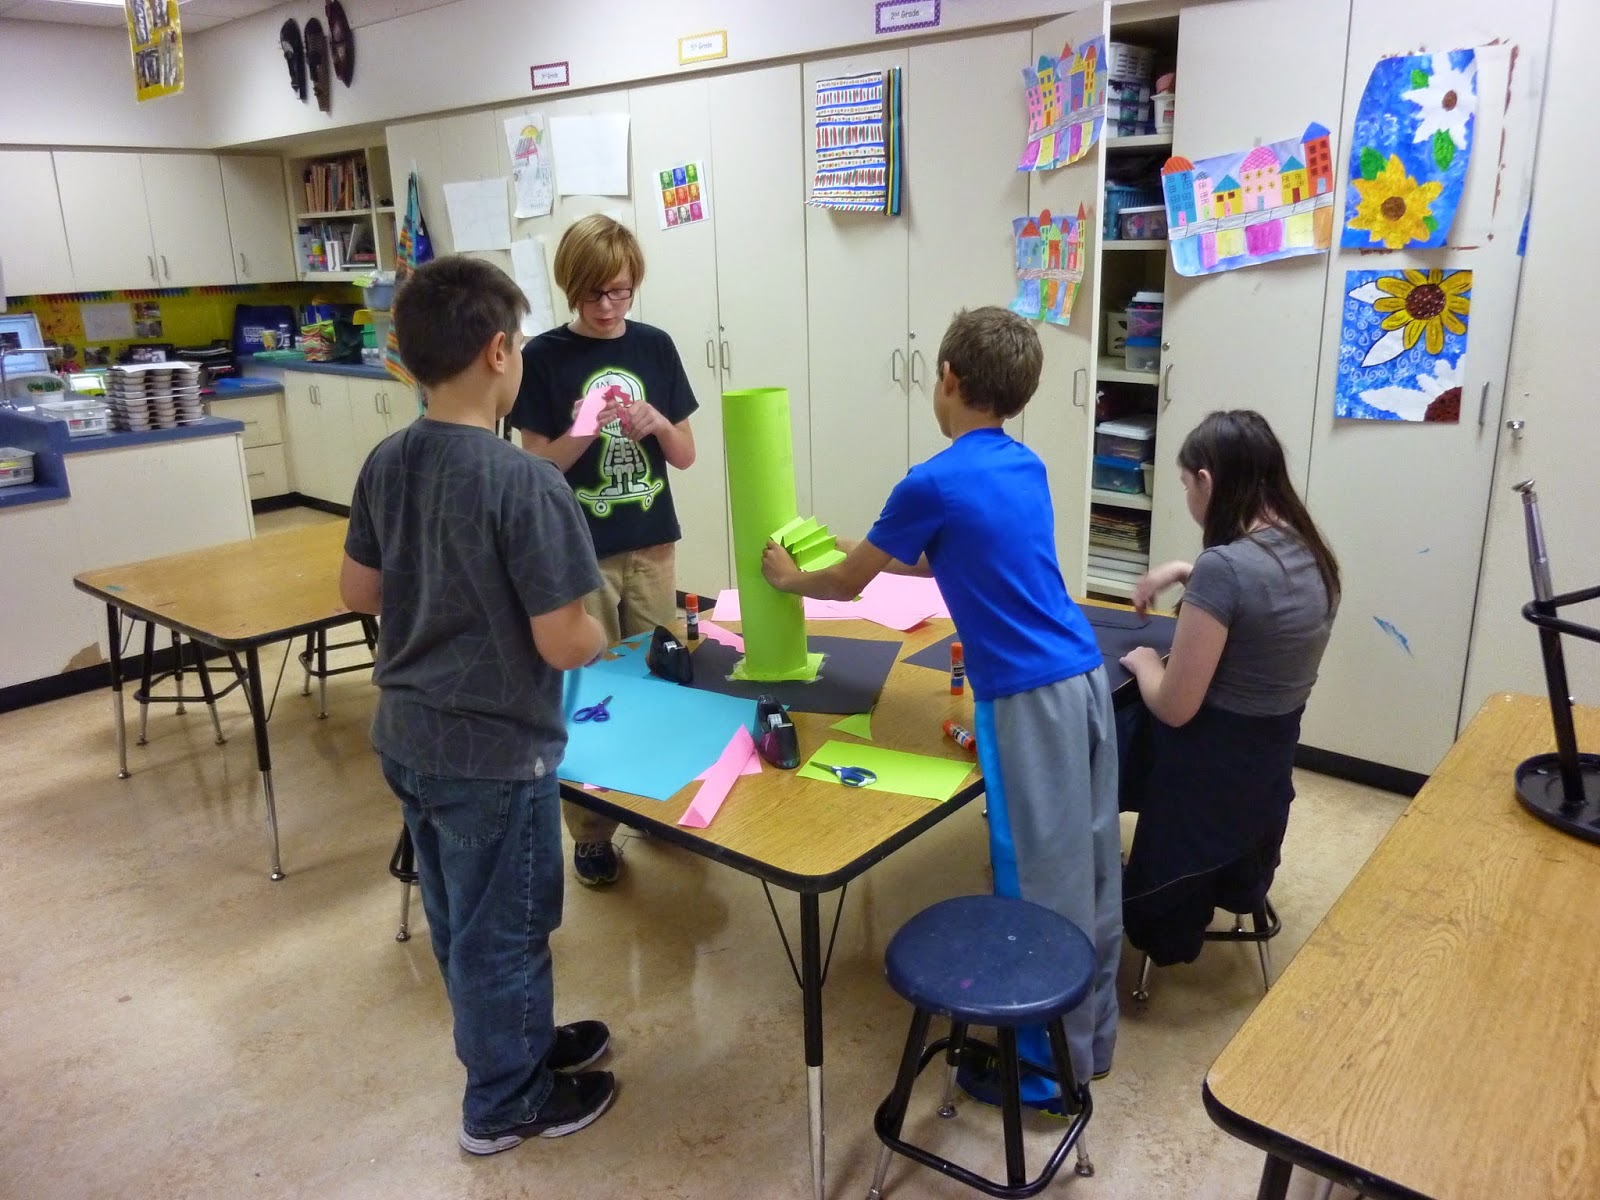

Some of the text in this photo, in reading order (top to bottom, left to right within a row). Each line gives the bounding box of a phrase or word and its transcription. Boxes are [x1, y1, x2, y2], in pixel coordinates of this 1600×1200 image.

[890, 9, 919, 20] 2nd Grade
[699, 41, 712, 50] Grade
